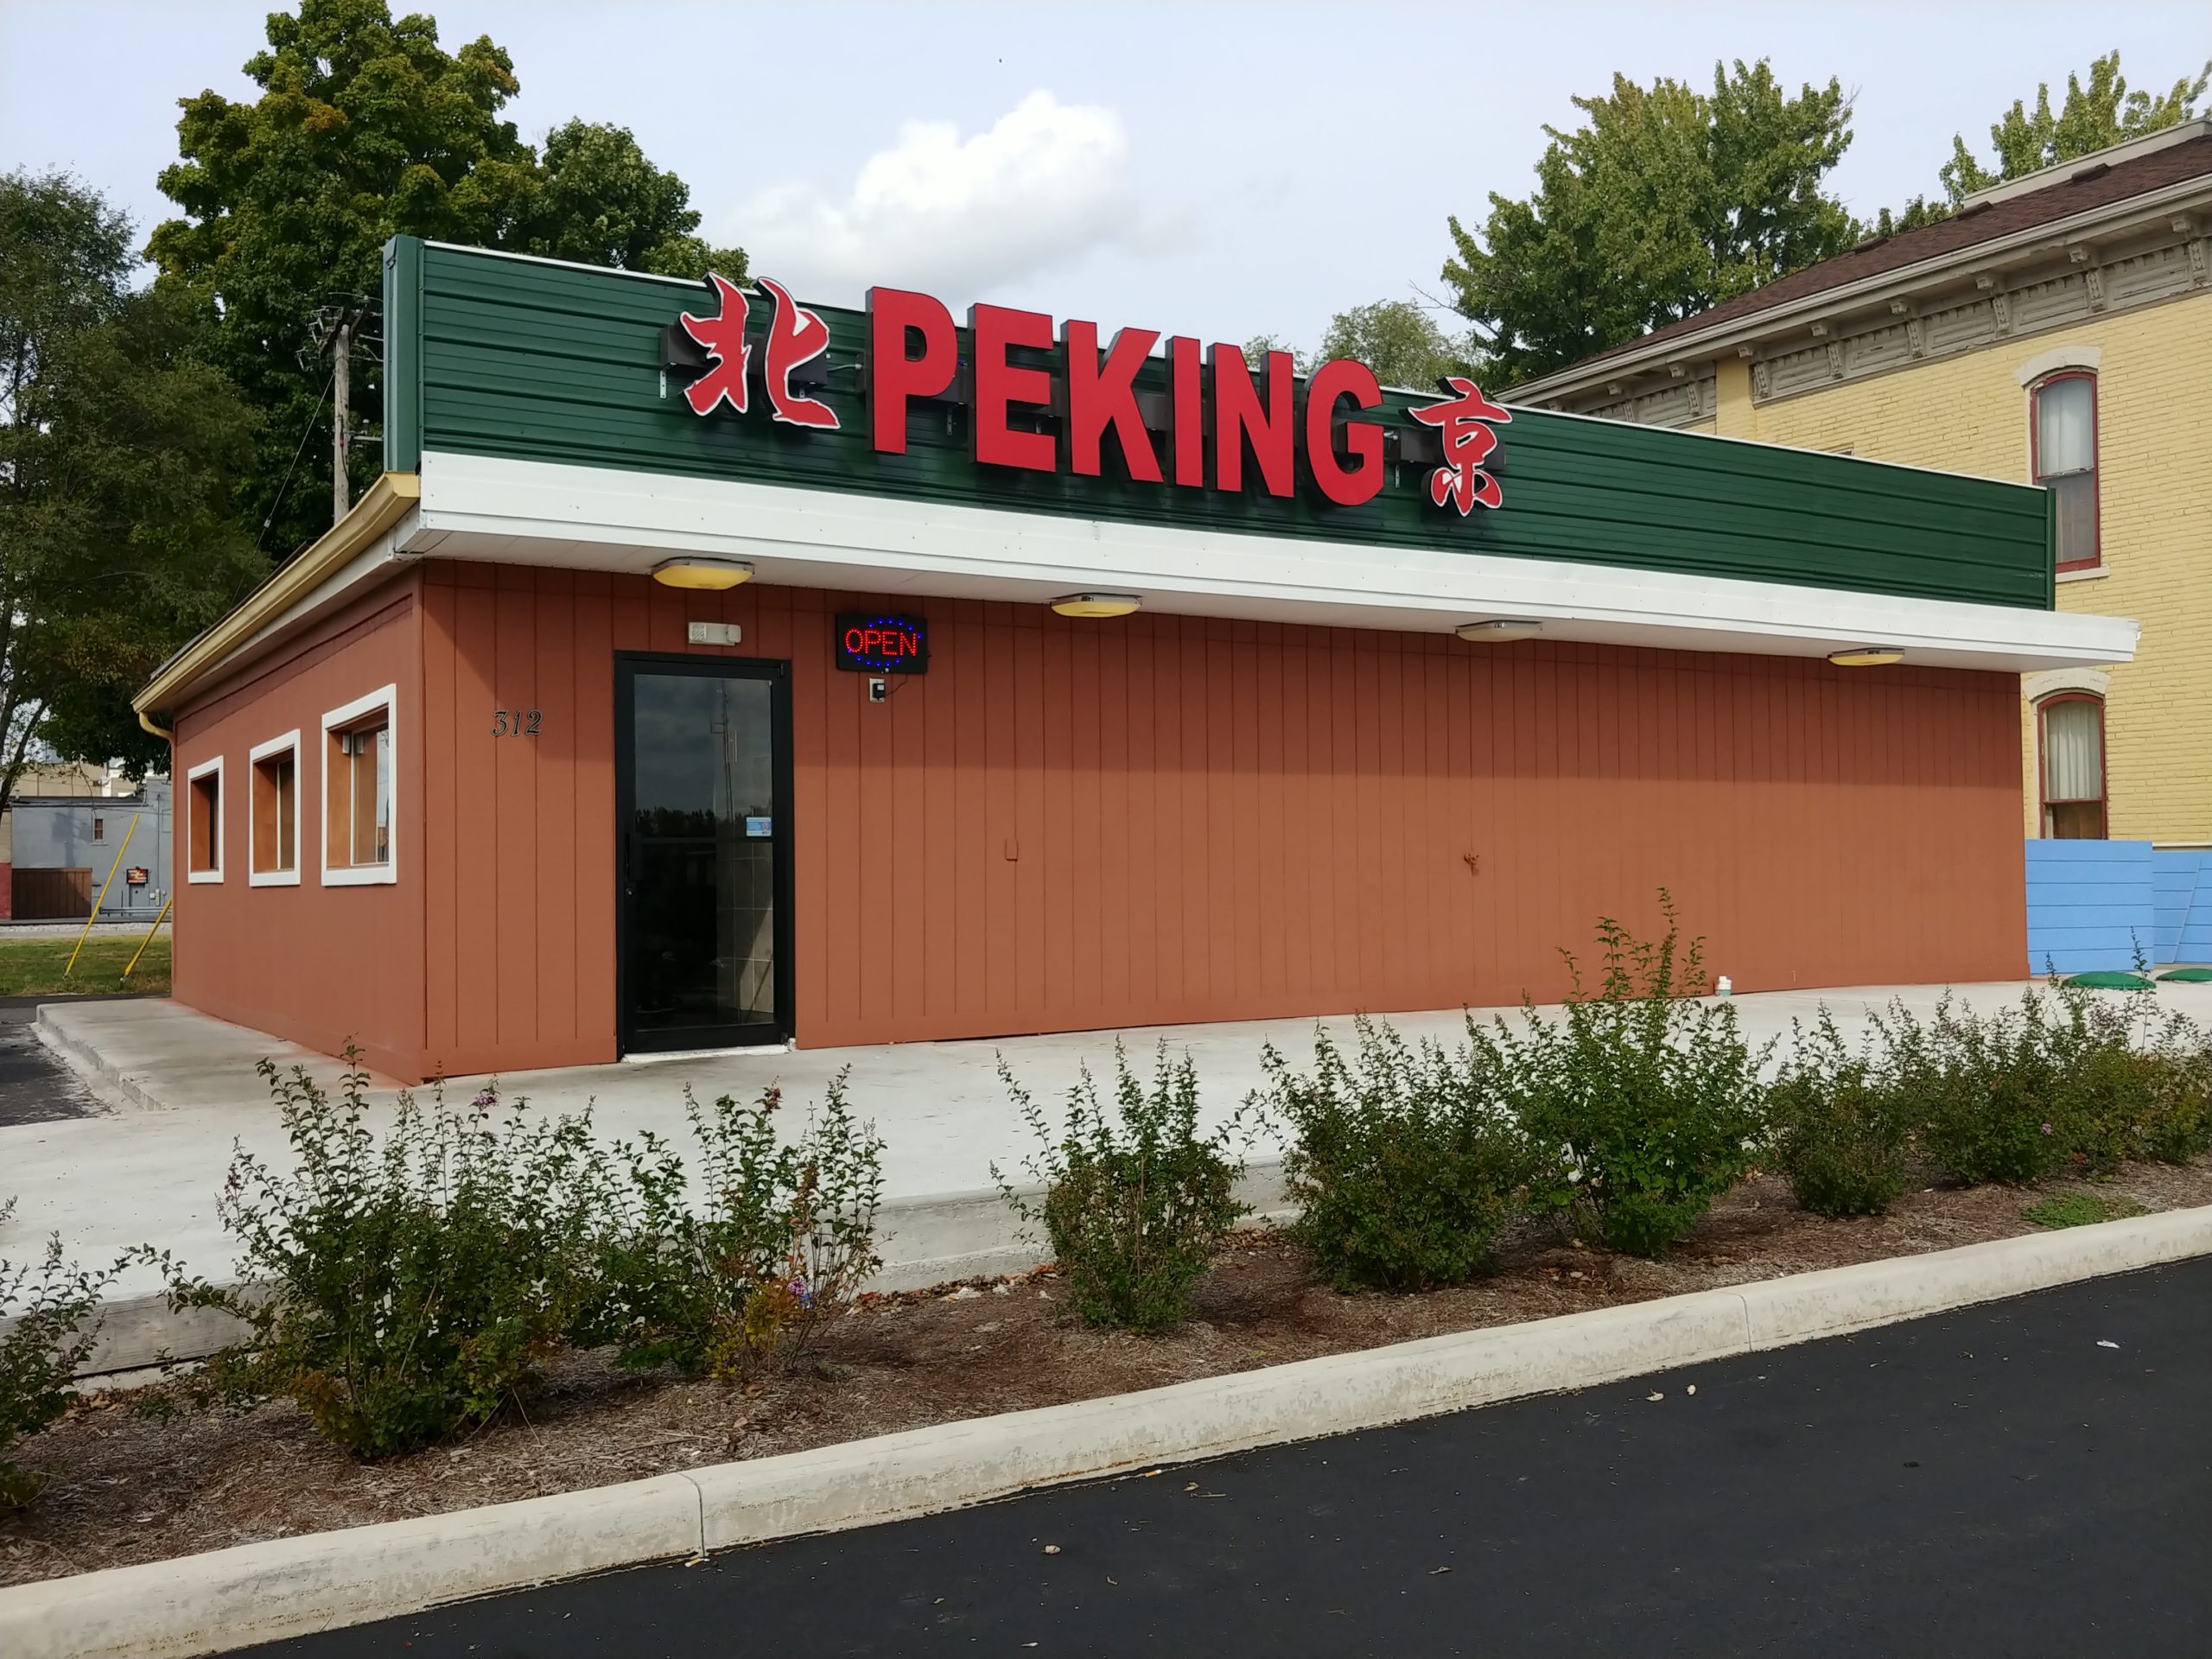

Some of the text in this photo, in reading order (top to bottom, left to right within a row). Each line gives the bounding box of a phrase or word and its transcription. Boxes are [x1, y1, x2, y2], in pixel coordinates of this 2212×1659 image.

[681, 271, 841, 430] 北
[866, 287, 1383, 506] PEKING
[1407, 376, 1513, 518] 京
[844, 628, 918, 658] OPEN
[491, 709, 543, 737] 312
